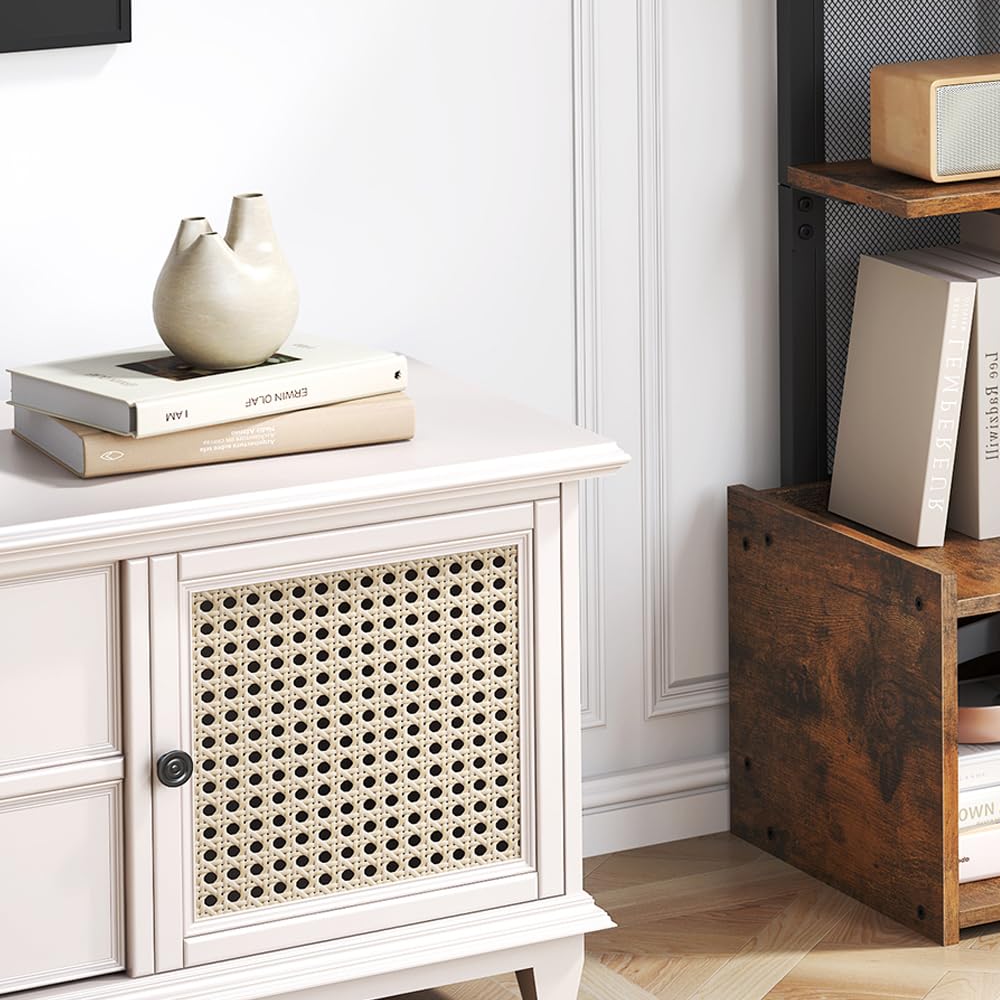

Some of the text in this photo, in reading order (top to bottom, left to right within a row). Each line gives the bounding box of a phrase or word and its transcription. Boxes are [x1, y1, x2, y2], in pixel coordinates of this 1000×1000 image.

[244, 387, 308, 408] ERWIN OLAF
[165, 410, 183, 422] AM
